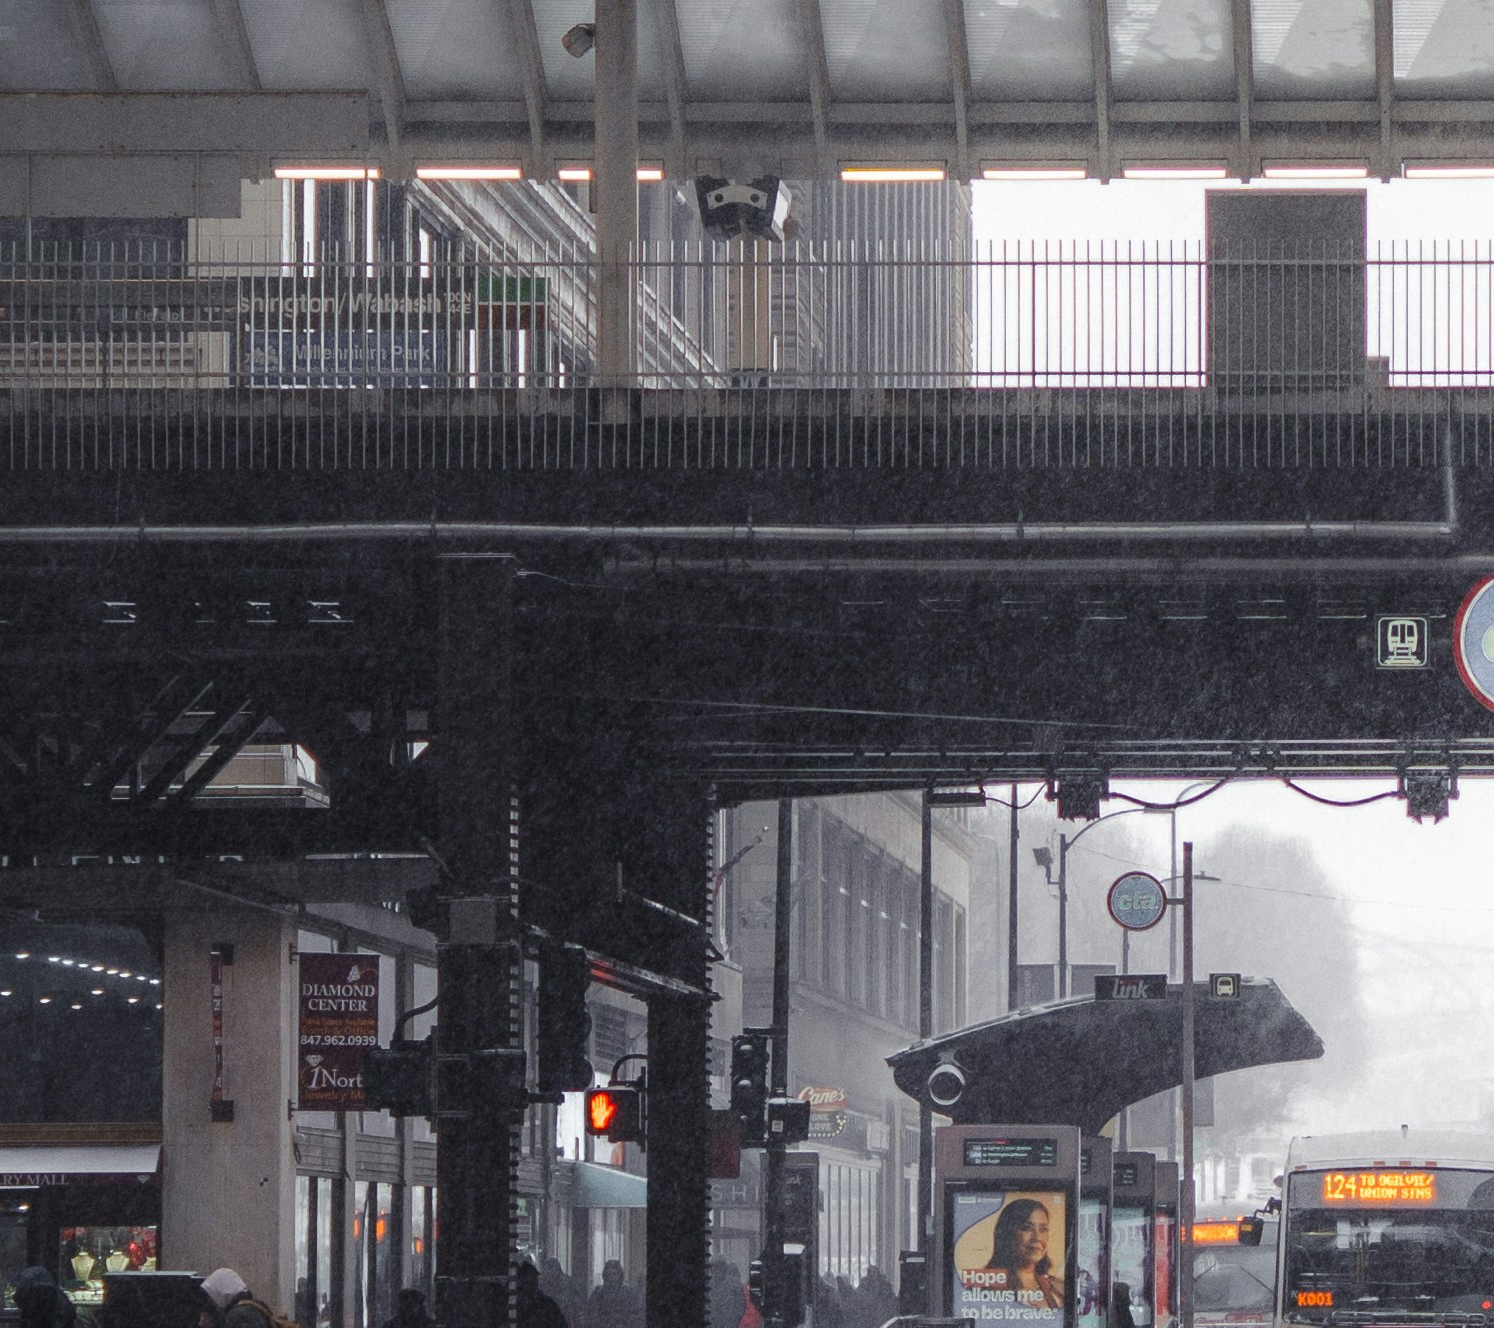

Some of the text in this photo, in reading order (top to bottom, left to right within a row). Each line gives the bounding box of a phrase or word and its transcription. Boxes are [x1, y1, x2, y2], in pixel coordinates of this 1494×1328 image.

[1117, 891, 1159, 911] cta
[302, 984, 376, 997] DIAMOND
[308, 999, 368, 1012] CENTER
[300, 1035, 377, 1046] 847.962.0939
[797, 1085, 845, 1103] Cane's
[26, 1173, 70, 1186] MALL
[1325, 1174, 1357, 1200] 124
[1360, 1175, 1376, 1187] TO
[1359, 1188, 1398, 1199] UNION
[963, 1271, 1009, 1287] Hope
[962, 1288, 1045, 1303] allows me
[962, 1306, 979, 1320] to
[981, 1305, 1004, 1320] be
